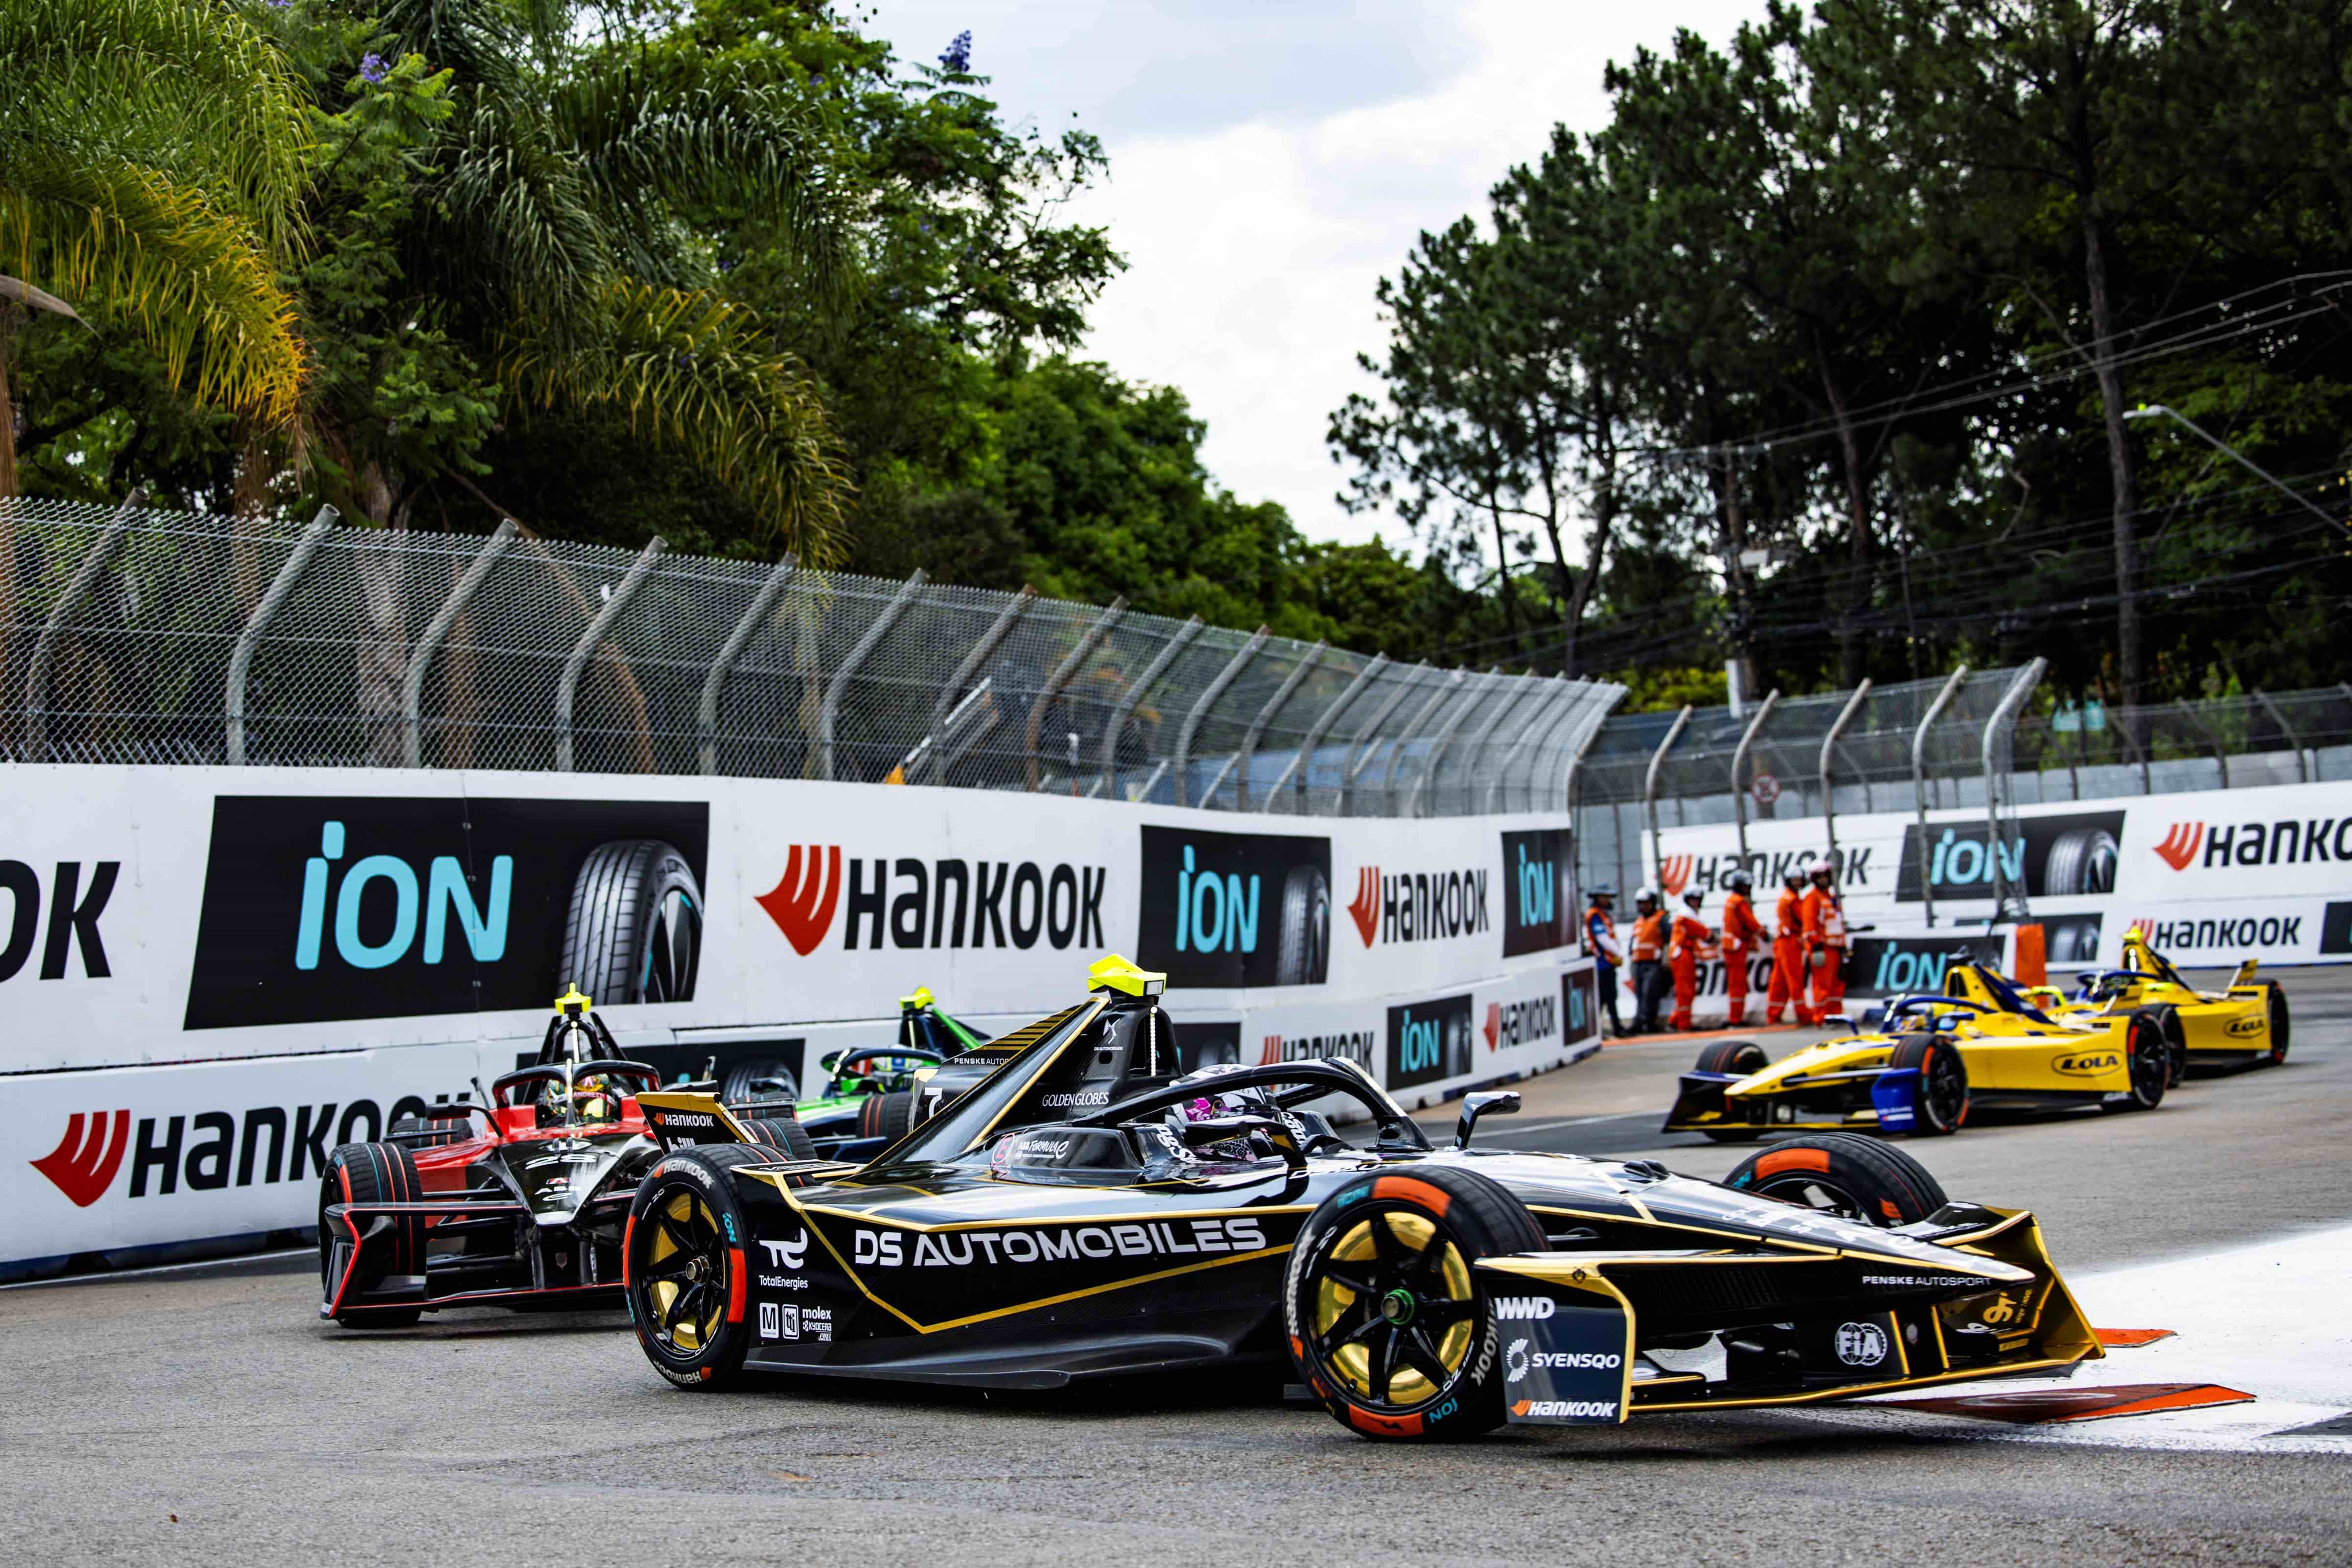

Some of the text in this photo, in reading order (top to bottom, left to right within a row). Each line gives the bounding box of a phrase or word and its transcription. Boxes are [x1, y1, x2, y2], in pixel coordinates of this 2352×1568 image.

[855, 1229, 903, 1267] DS
[913, 1218, 1267, 1267] AUTOMOBILES
[759, 1274, 808, 1291] TotalEnergies
[1862, 1276, 1992, 1286] PENSKE AUTOSPORT
[802, 1306, 832, 1320] molex
[1494, 1297, 1556, 1320] WWD
[808, 1322, 832, 1331] KYOCERA
[1532, 1352, 1620, 1369] SYENSQO
